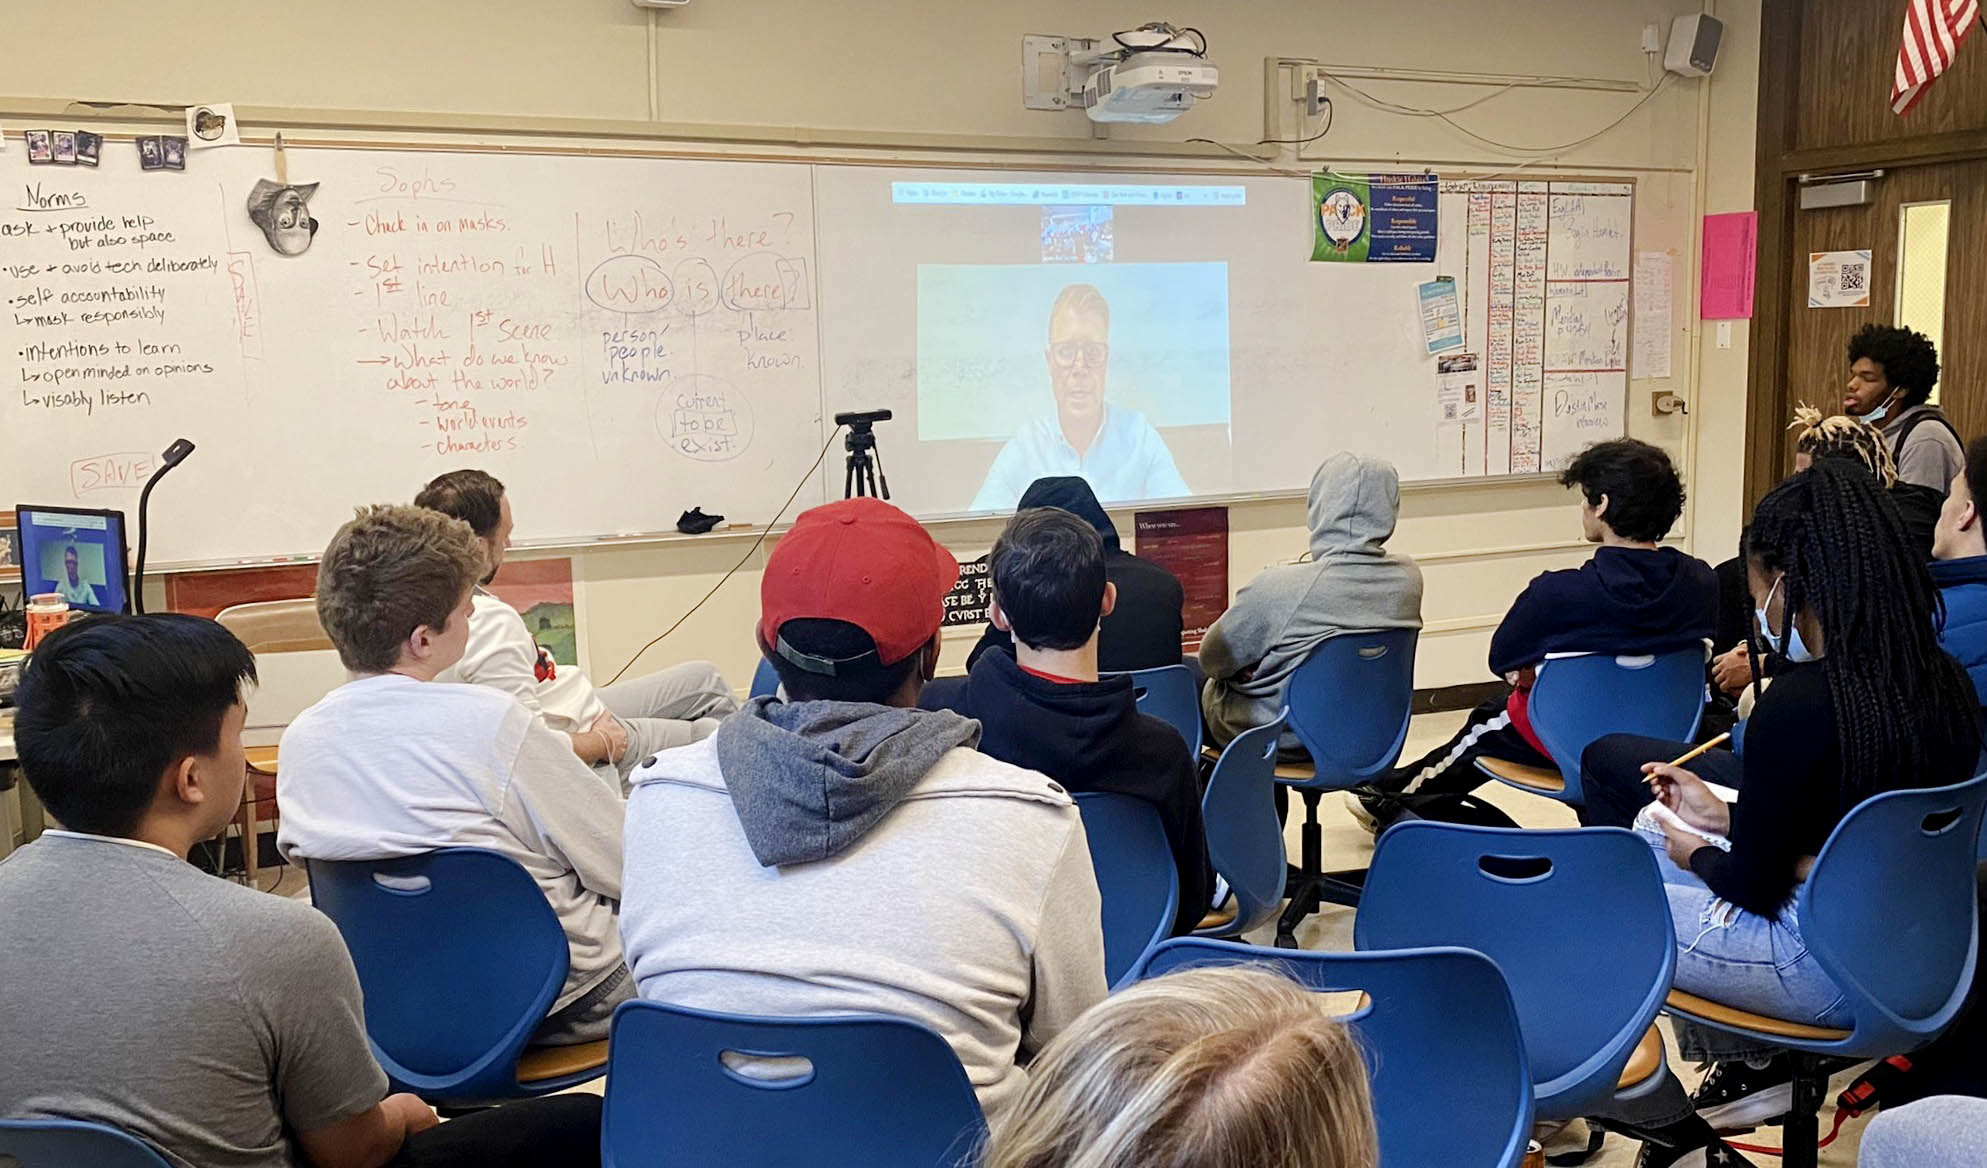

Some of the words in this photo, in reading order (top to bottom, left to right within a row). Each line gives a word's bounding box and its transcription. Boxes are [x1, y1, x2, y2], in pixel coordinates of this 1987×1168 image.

[376, 167, 457, 198] Sophs
[26, 182, 86, 208] Norms
[1320, 204, 1366, 217] PACK
[1, 218, 40, 236] ask
[59, 217, 116, 241] provide
[122, 215, 154, 233] help
[416, 215, 428, 233] in
[436, 220, 452, 234] on
[605, 209, 689, 256] Who's
[705, 211, 796, 250] there?
[68, 236, 93, 251] but
[97, 233, 126, 249] also
[131, 231, 176, 250] space
[10, 263, 40, 279] use
[61, 257, 102, 276] avoid
[105, 258, 143, 273] tech
[147, 255, 219, 276] deliberately
[366, 254, 405, 280] Set
[417, 253, 505, 276] intention
[541, 242, 557, 276] H
[15, 287, 54, 308] self
[61, 285, 165, 305] accountability
[416, 280, 450, 308] line
[601, 267, 669, 305] Who
[686, 278, 710, 300] is
[35, 312, 75, 326] mask
[81, 306, 166, 325] responsibly
[377, 312, 450, 343] Watch
[497, 318, 553, 344] Scene
[25, 340, 110, 362] intentions
[114, 341, 131, 355] to
[138, 339, 181, 354] learn
[393, 343, 450, 371] What
[463, 343, 485, 368] do
[491, 353, 516, 367] we
[521, 343, 569, 367] know
[136, 366, 150, 376] on
[154, 361, 214, 379] opinions
[386, 369, 438, 391] about
[452, 368, 485, 392] the
[42, 388, 93, 416] visably
[100, 388, 151, 407] listen
[432, 392, 474, 412] tone
[436, 408, 478, 433] world
[679, 415, 698, 432] to
[703, 413, 727, 432] be
[959, 563, 988, 576] REND
